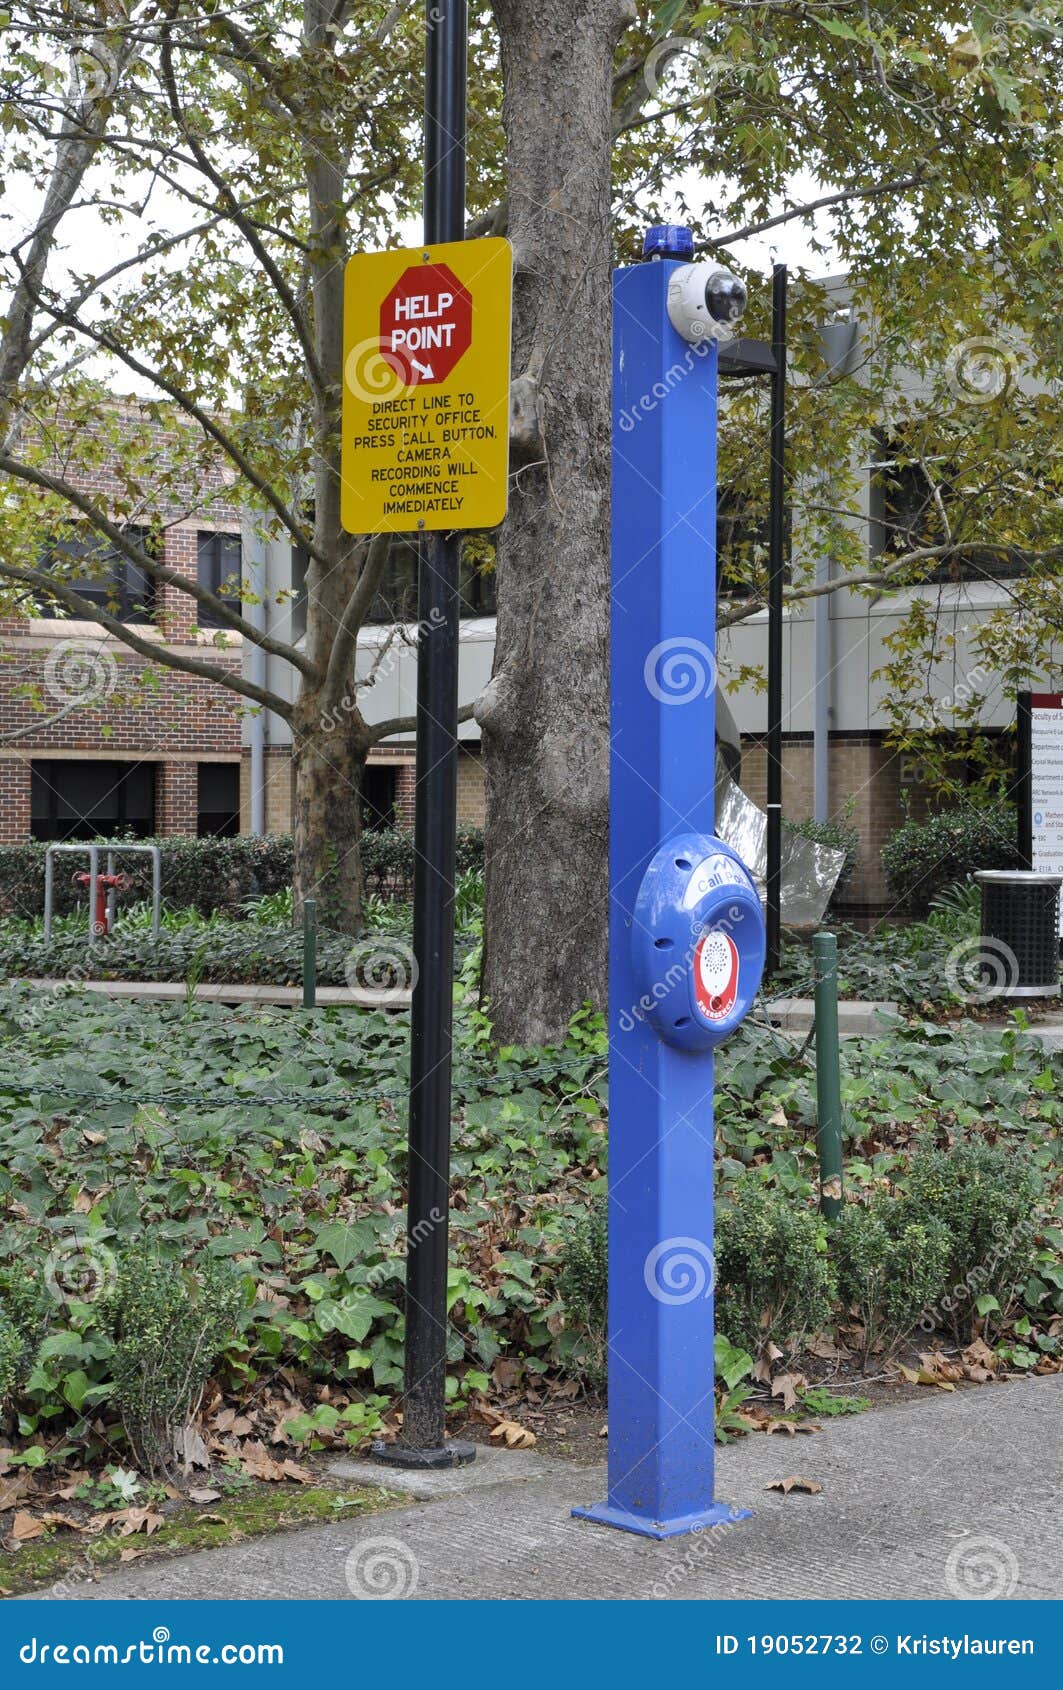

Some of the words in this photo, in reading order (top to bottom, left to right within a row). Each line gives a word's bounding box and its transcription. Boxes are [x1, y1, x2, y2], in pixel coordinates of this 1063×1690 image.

[394, 292, 454, 322] HELP
[391, 323, 456, 353] POINT
[372, 399, 416, 414] DIRECT
[423, 395, 451, 410] LINE
[458, 393, 474, 406] TO
[367, 415, 429, 431] SECURITY
[435, 410, 481, 426] OFFICE
[354, 434, 396, 449] PRESS
[403, 431, 436, 445] CALL
[442, 425, 497, 442] BUTTON.
[397, 447, 451, 463] CAMERA
[371, 464, 441, 481] RECORDING
[447, 462, 478, 476] WILL
[389, 480, 459, 497] COMMENCE
[383, 497, 464, 514] IMMEDIATELY
[698, 872, 723, 892] Call
